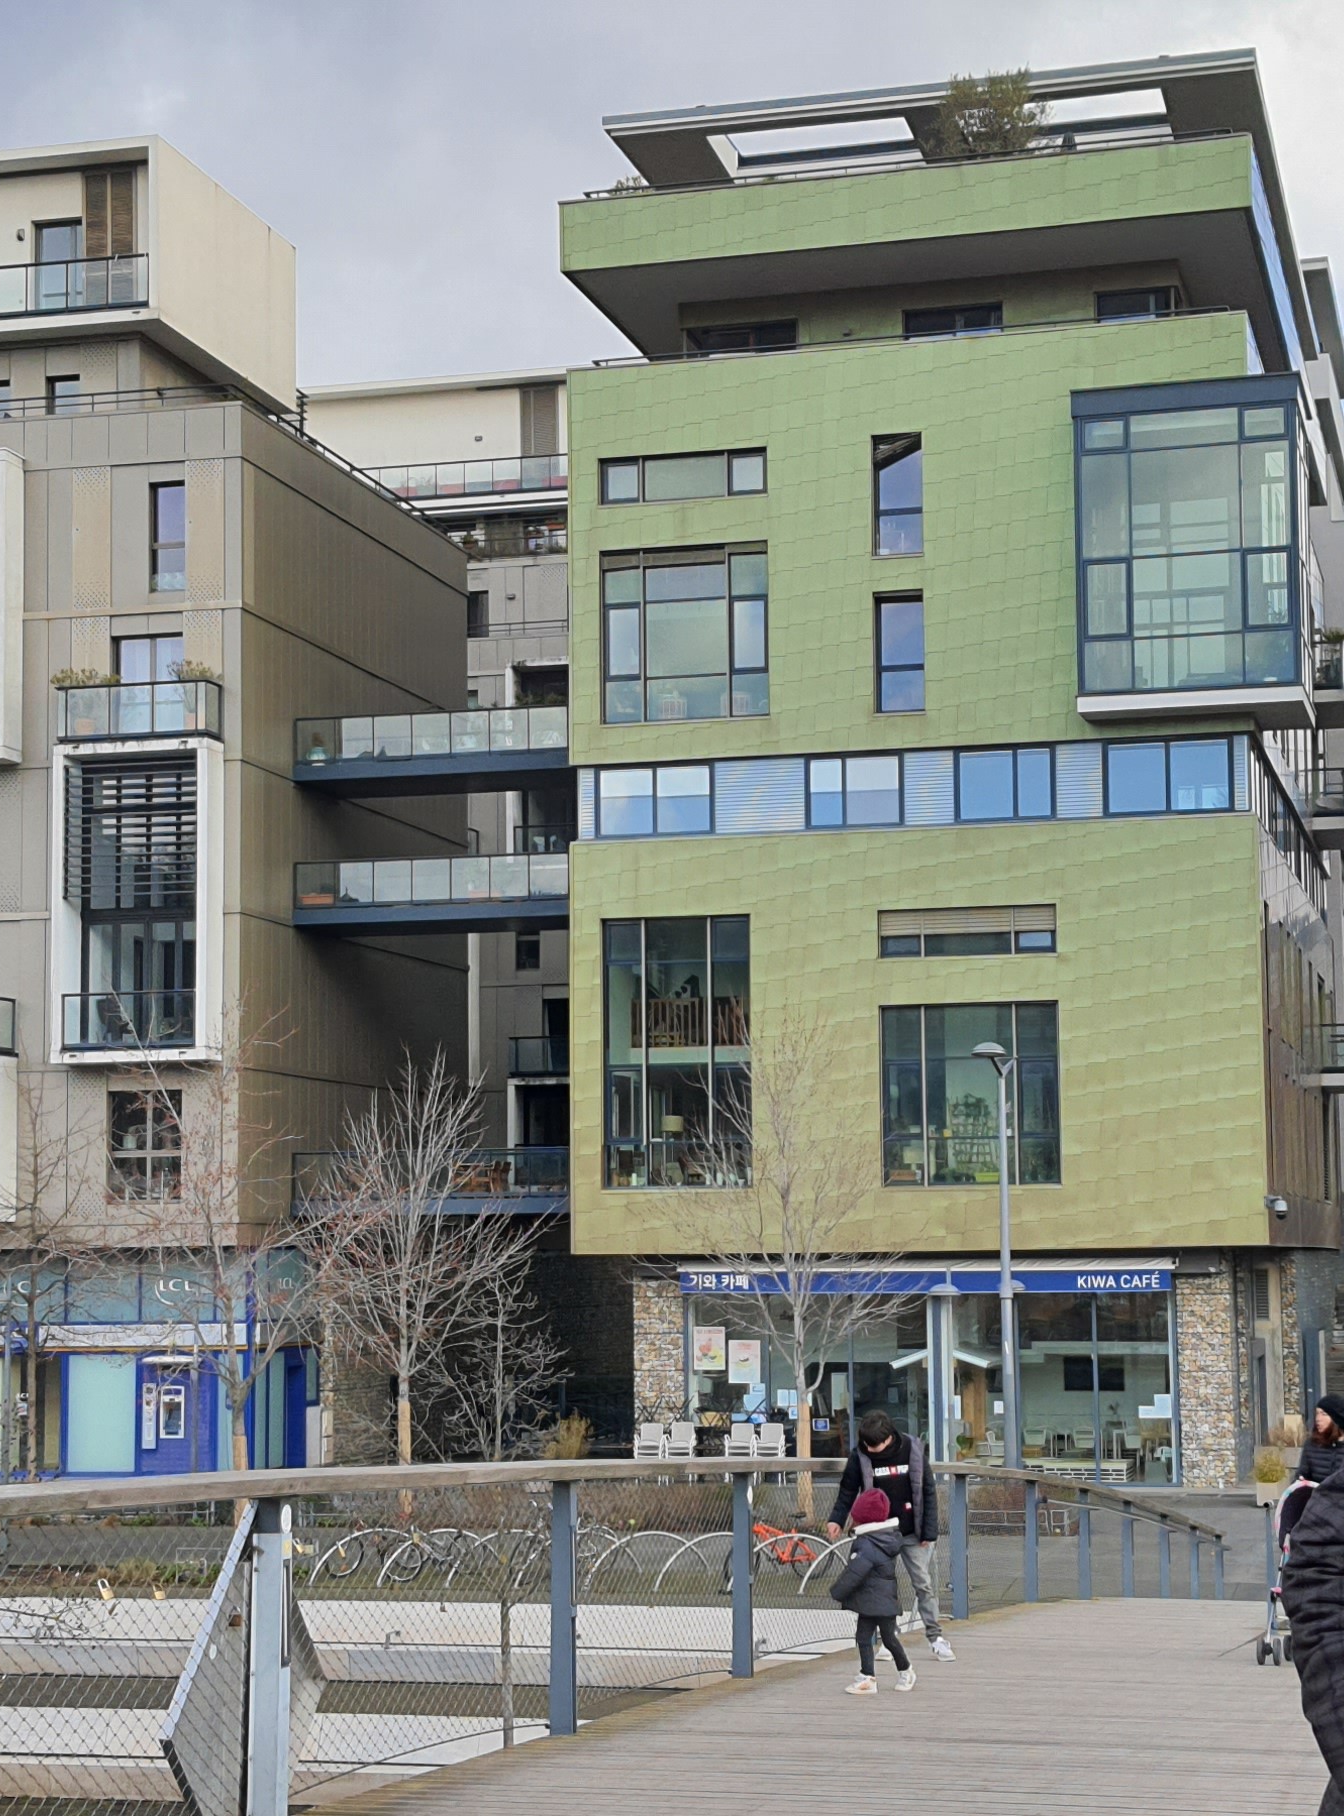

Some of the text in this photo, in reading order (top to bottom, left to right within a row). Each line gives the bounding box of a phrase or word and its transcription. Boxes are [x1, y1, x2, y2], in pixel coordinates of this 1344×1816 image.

[159, 1278, 195, 1292] LCL
[689, 1273, 749, 1290] 기와 카페
[1077, 1271, 1161, 1289] KIWA CAFÉ
